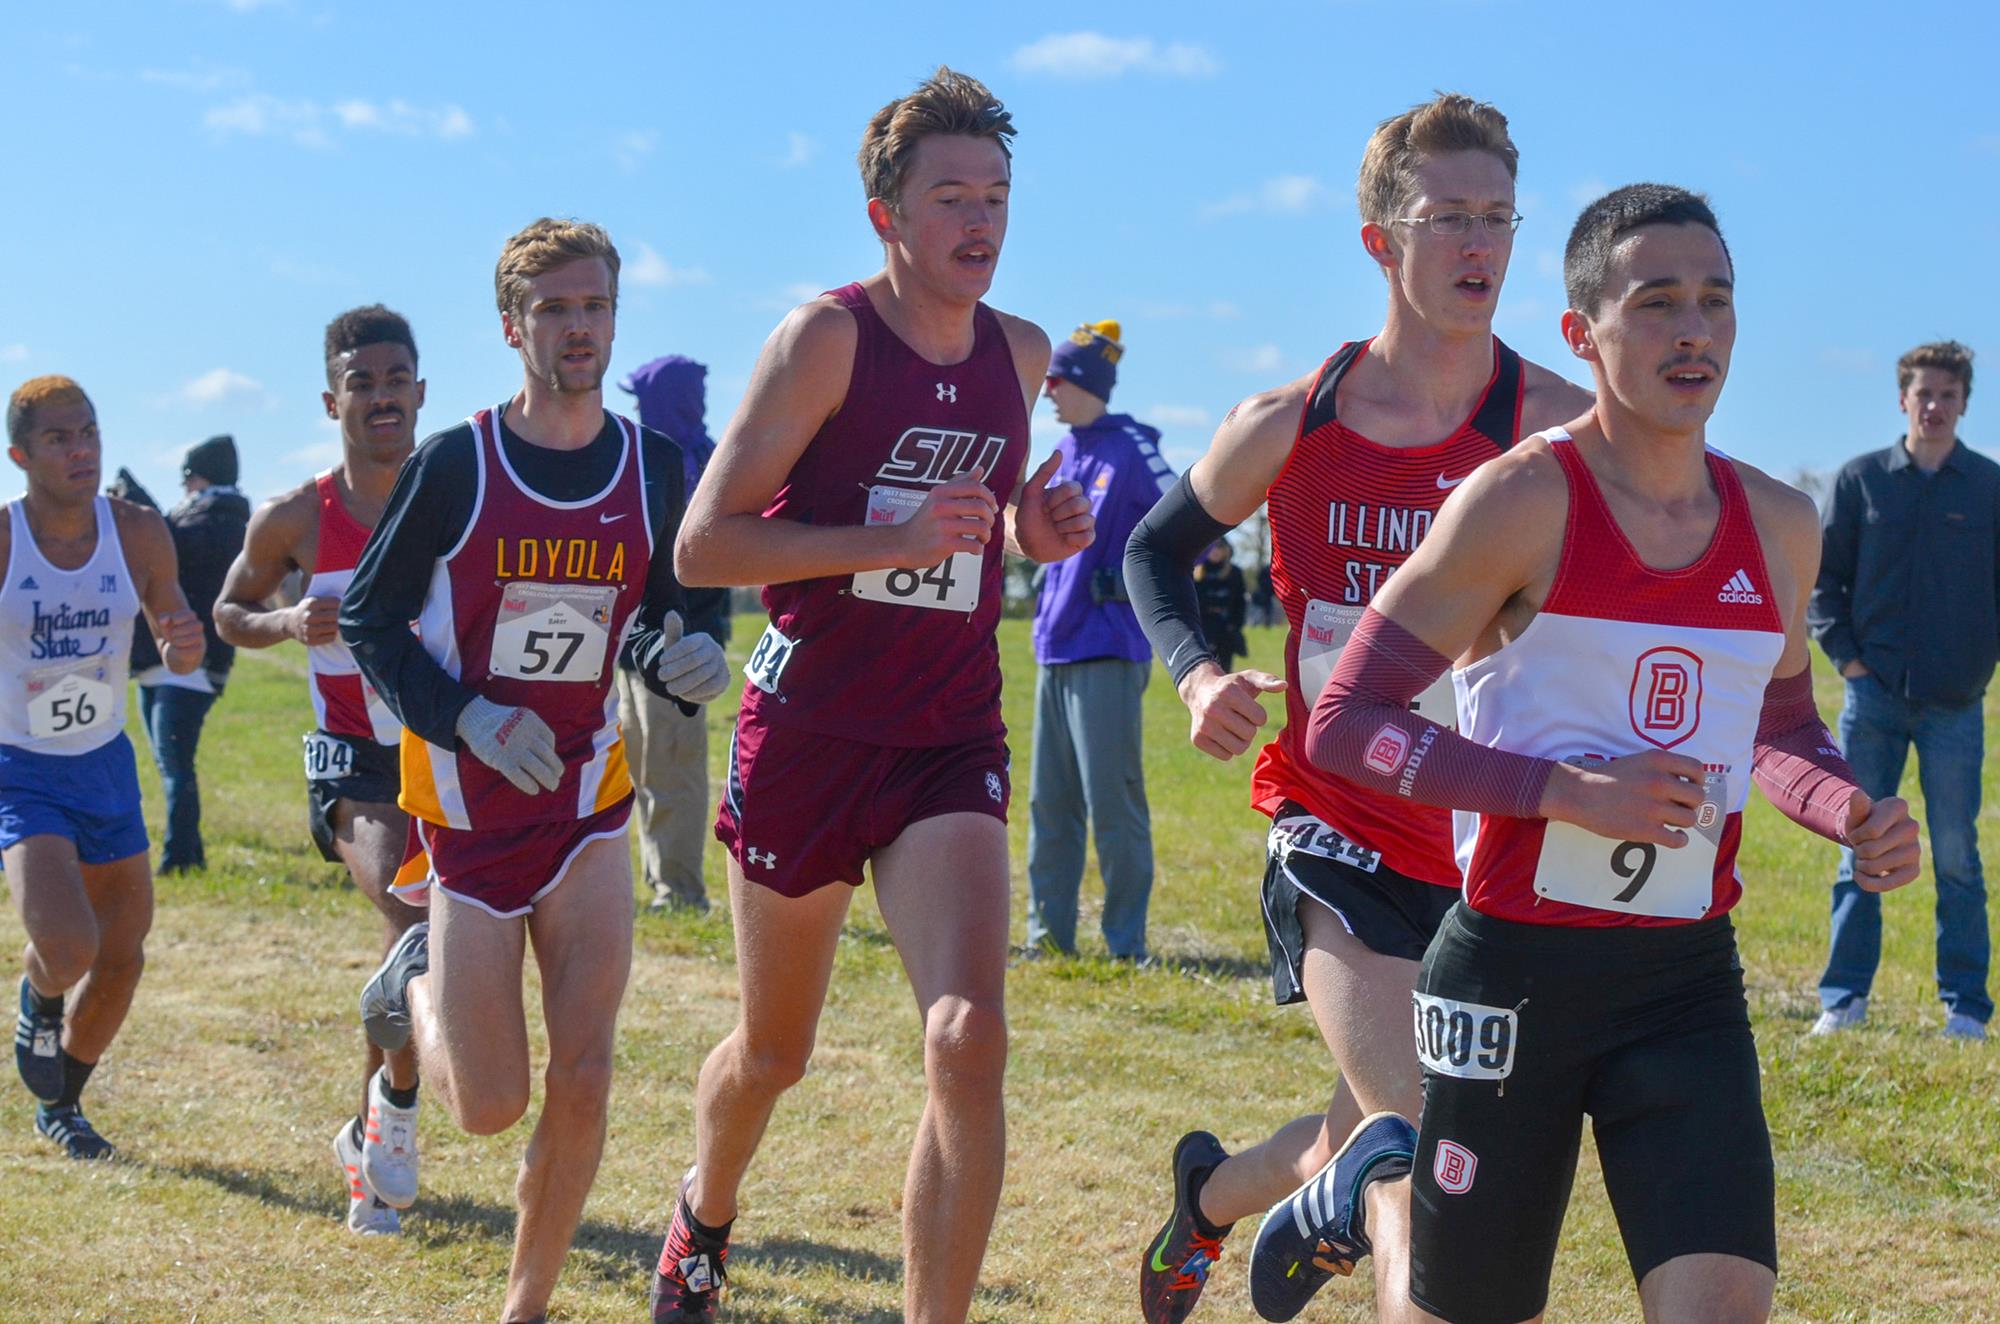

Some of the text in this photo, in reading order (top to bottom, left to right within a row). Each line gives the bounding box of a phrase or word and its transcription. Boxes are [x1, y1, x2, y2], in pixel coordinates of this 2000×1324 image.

[876, 427, 1007, 484] SIU
[1327, 501, 1432, 551] ILLINO
[496, 537, 625, 581] LOYOLA
[99, 575, 117, 593] JM
[1344, 561, 1400, 603] ST
[1718, 591, 1763, 605] adidas
[32, 601, 110, 634] Indiana
[1323, 614, 1345, 624] CROSS
[31, 634, 107, 660] State
[519, 630, 585, 675] 57
[752, 632, 788, 684] 84
[51, 693, 97, 732] 56
[1644, 663, 1688, 729] B
[1398, 725, 1440, 797] BRADLEY
[1610, 841, 1658, 903] 9
